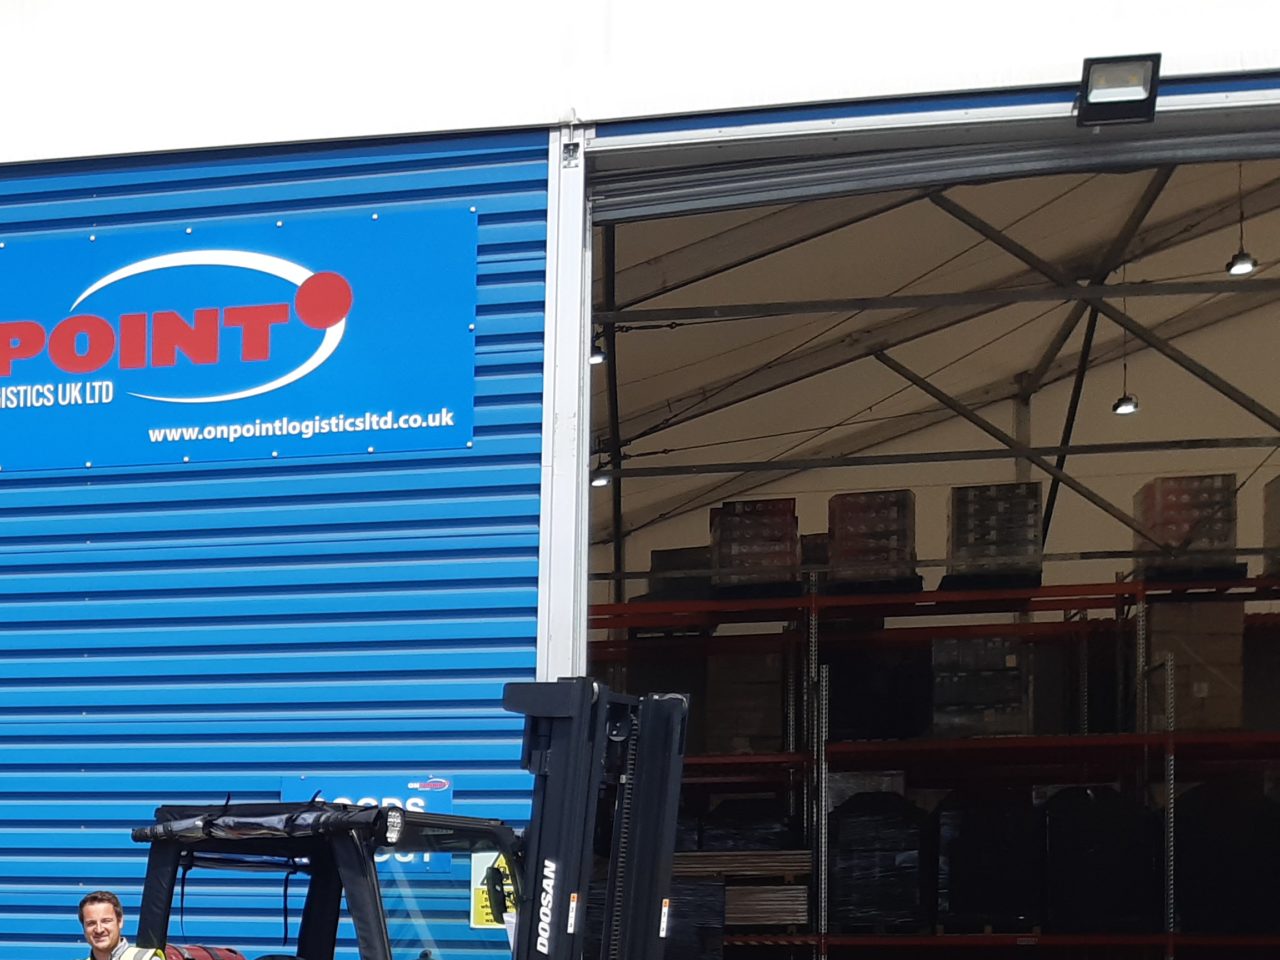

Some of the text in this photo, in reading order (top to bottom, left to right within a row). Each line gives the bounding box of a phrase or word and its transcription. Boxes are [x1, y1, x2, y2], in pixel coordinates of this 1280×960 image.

[58, 382, 82, 406] UK
[86, 381, 113, 404] LTD
[148, 408, 454, 443] www.onpointlogisticsltd.co.uk
[536, 859, 556, 955] DOOSAN
